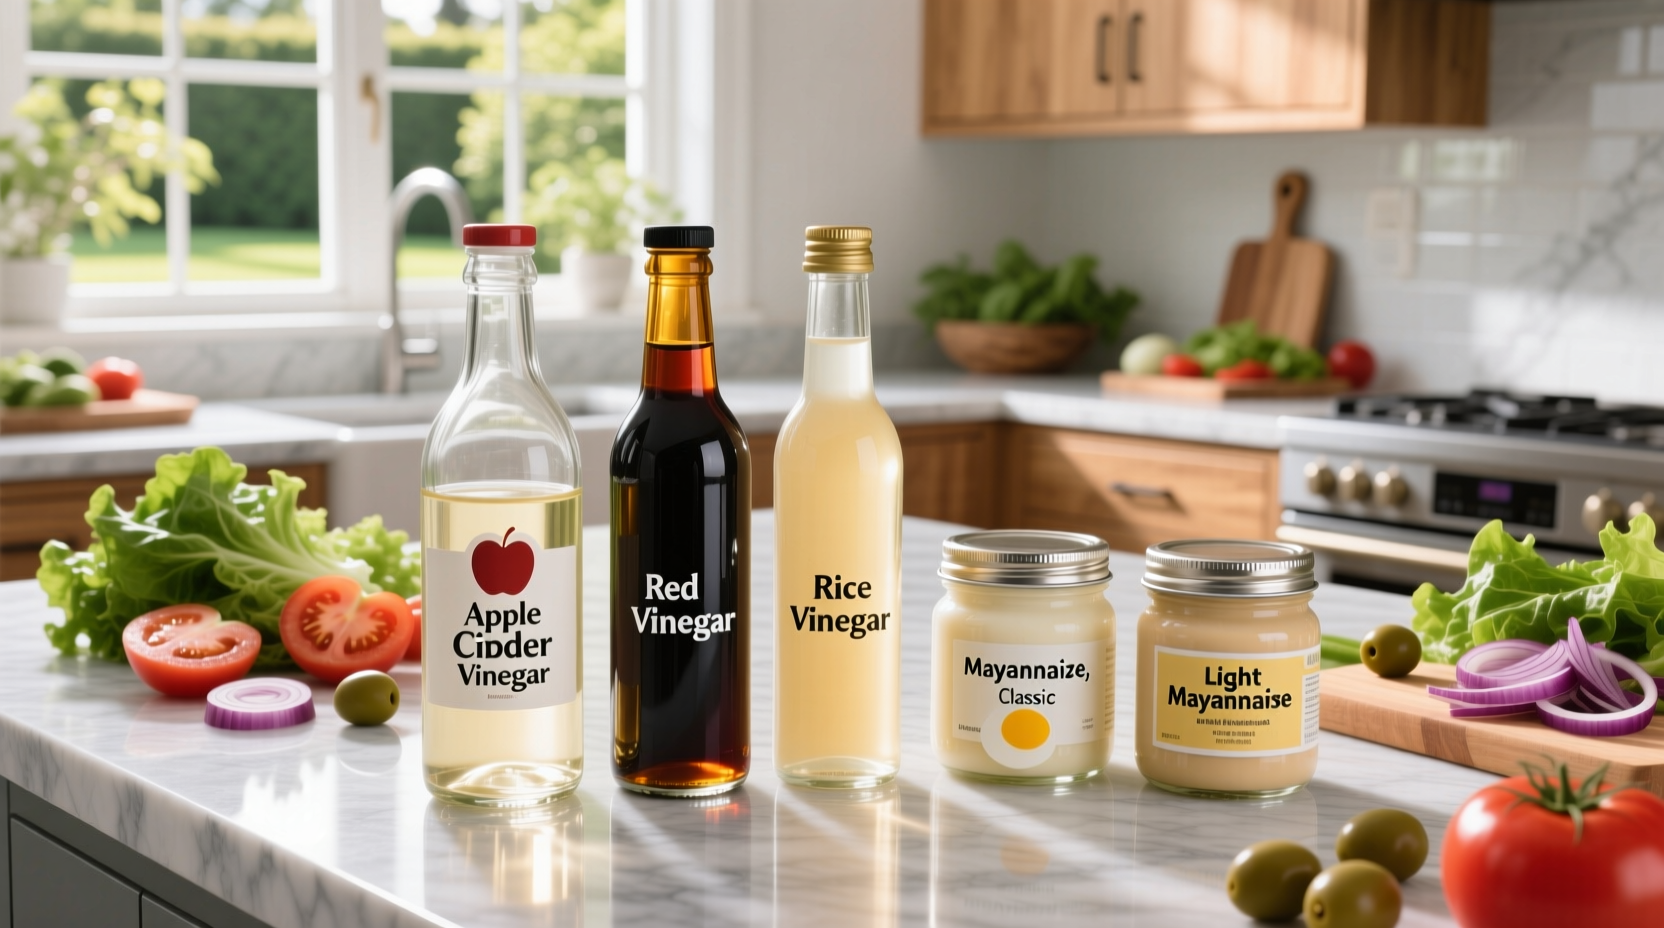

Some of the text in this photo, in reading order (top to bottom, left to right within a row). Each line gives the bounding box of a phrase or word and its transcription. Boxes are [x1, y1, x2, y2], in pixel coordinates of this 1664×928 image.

[645, 572, 699, 601] Red
[813, 574, 872, 600] Rice
[463, 600, 541, 634] Apple
[630, 605, 736, 642] Vinegar
[789, 605, 891, 640] Vinegar
[457, 663, 550, 693] Vinegar
[963, 656, 1090, 685] Mayannaize,
[1204, 665, 1262, 693] Light
[998, 687, 1056, 706] Classic
[1167, 684, 1292, 715] Mayannaise
